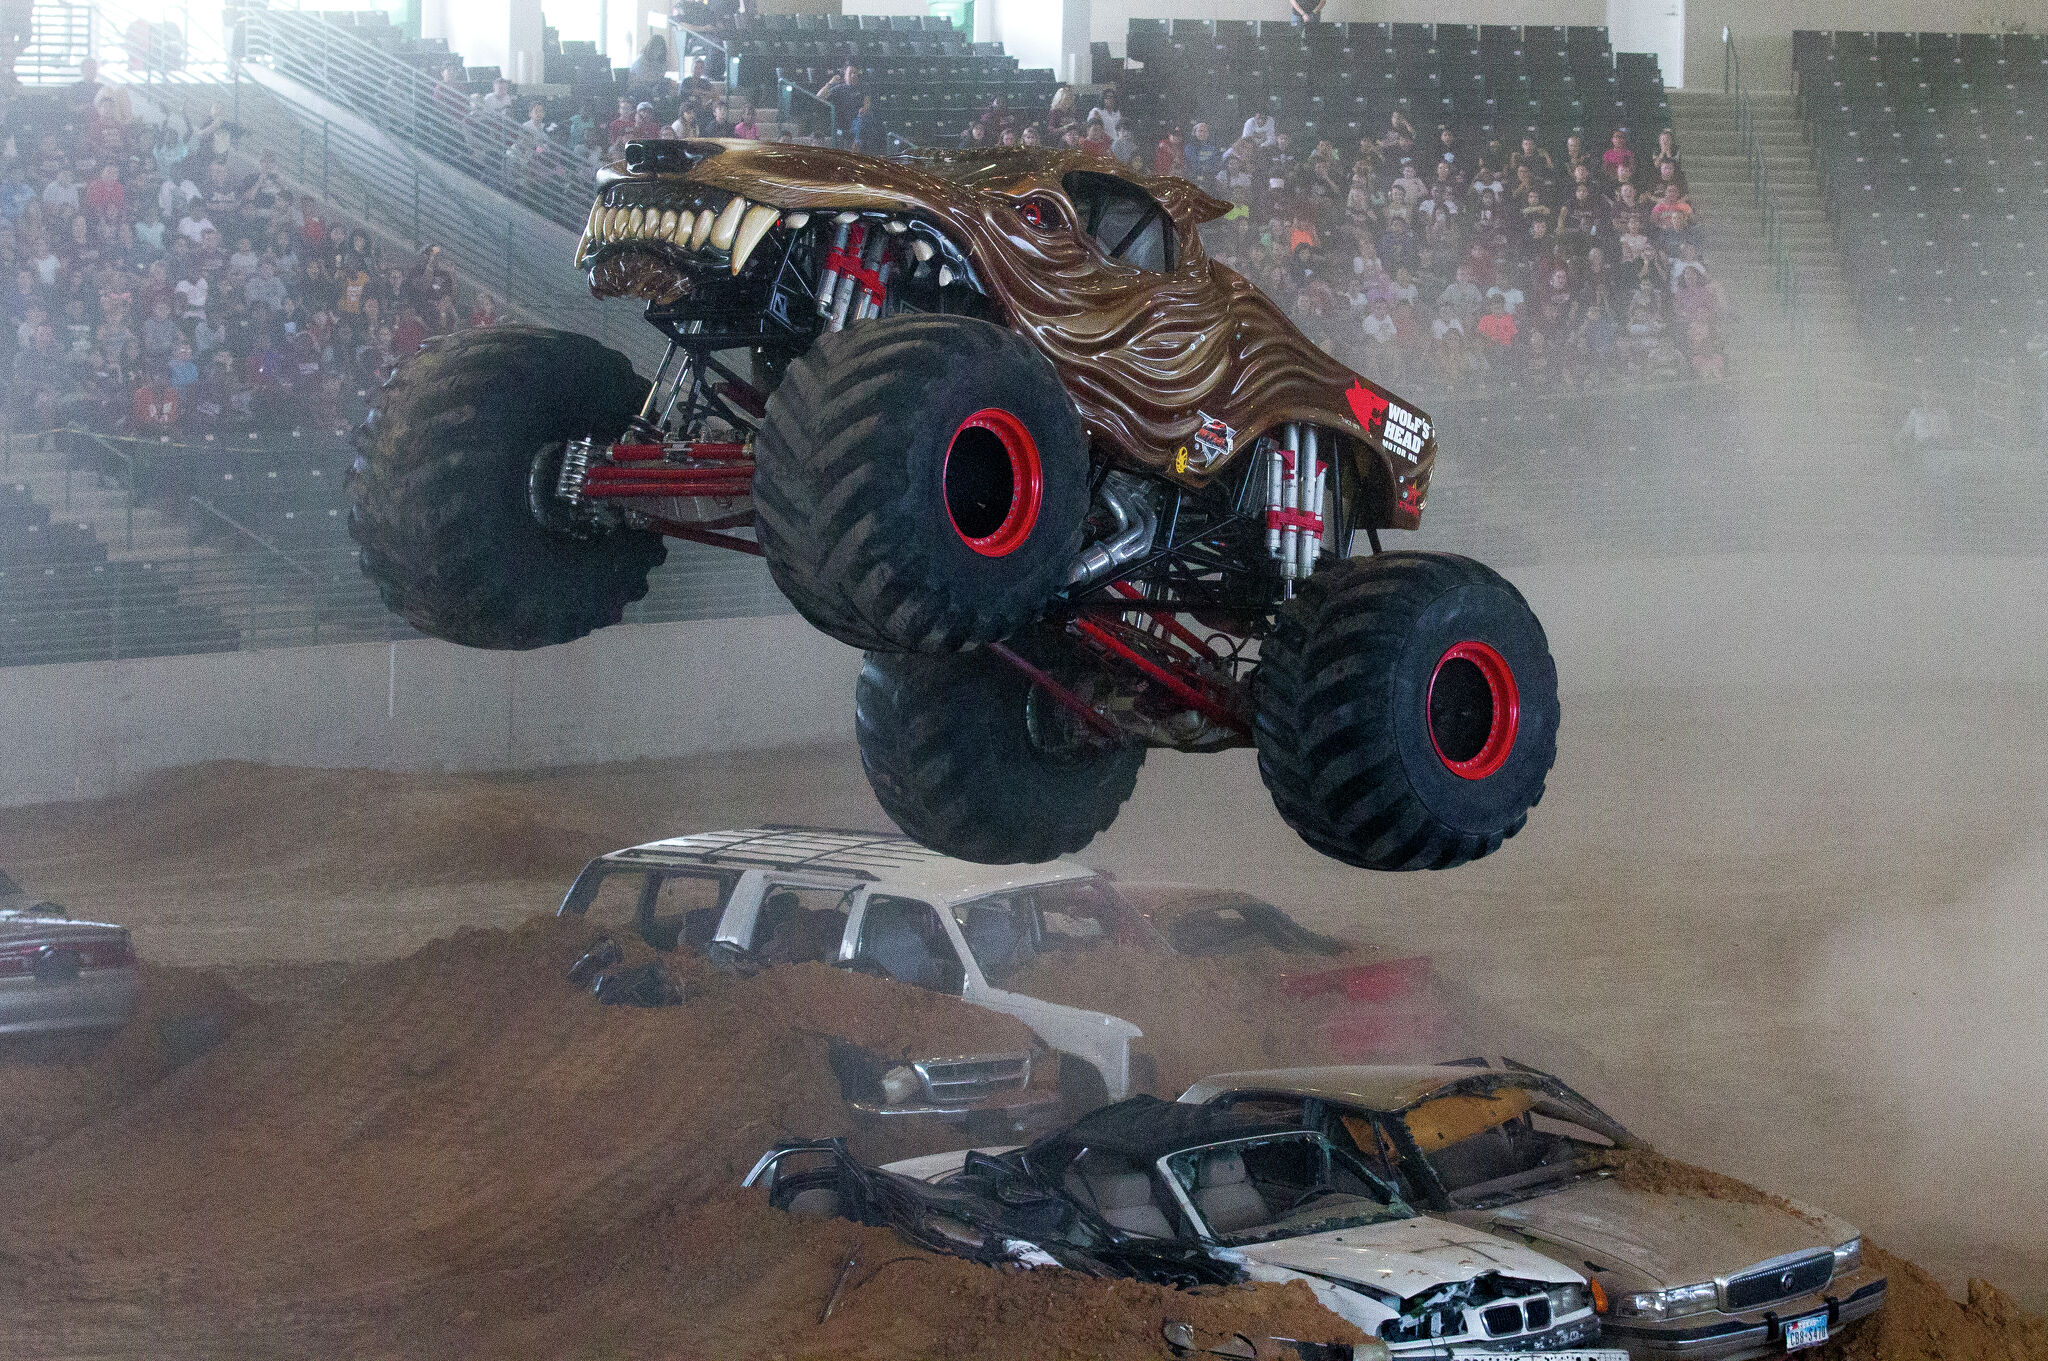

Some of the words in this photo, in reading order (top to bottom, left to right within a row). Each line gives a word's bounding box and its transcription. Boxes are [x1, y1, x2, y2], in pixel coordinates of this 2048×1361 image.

[1389, 402, 1430, 440] WOLF'S
[1382, 439, 1406, 458] MOTOR
[1408, 452, 1418, 465] OIL
